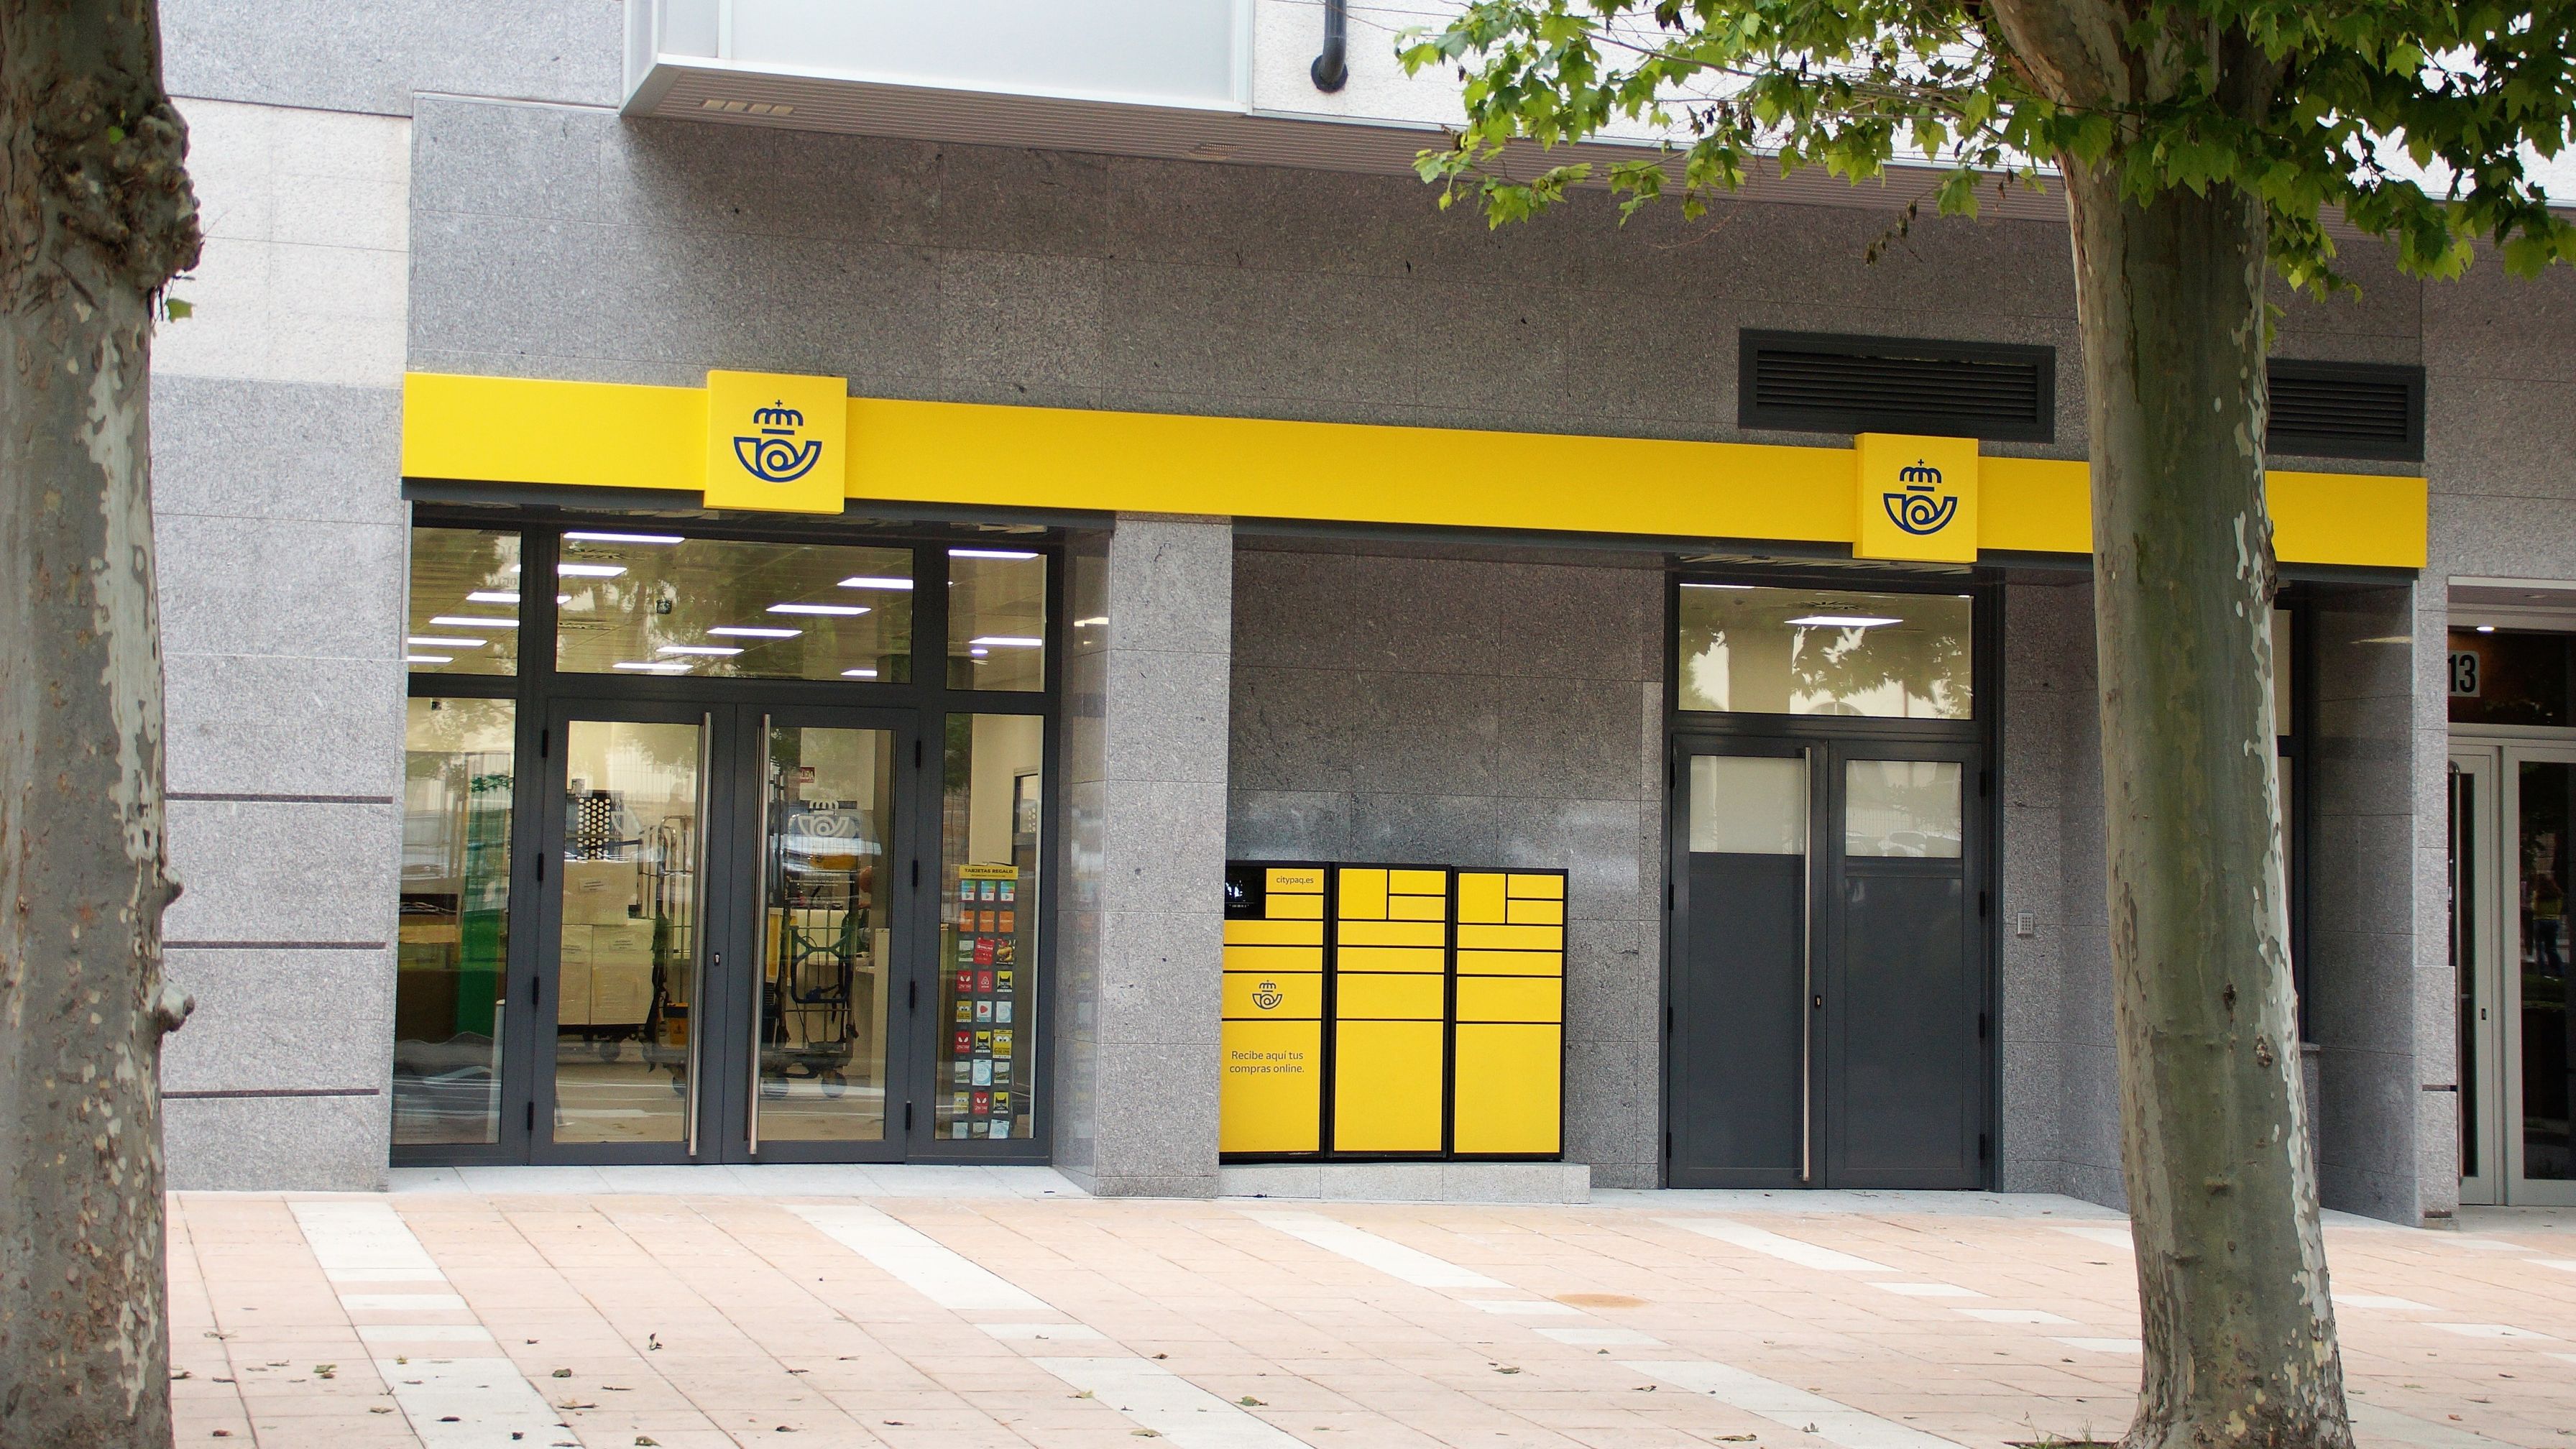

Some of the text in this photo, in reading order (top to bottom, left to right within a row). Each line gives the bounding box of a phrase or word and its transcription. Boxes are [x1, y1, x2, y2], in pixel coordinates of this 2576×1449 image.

[2447, 653, 2477, 694] 13
[1276, 875, 1314, 886] citypaq.es
[1231, 1050, 1264, 1059] Recibe
[1266, 1050, 1287, 1062] aquí
[1229, 1064, 1305, 1075] compras online.
